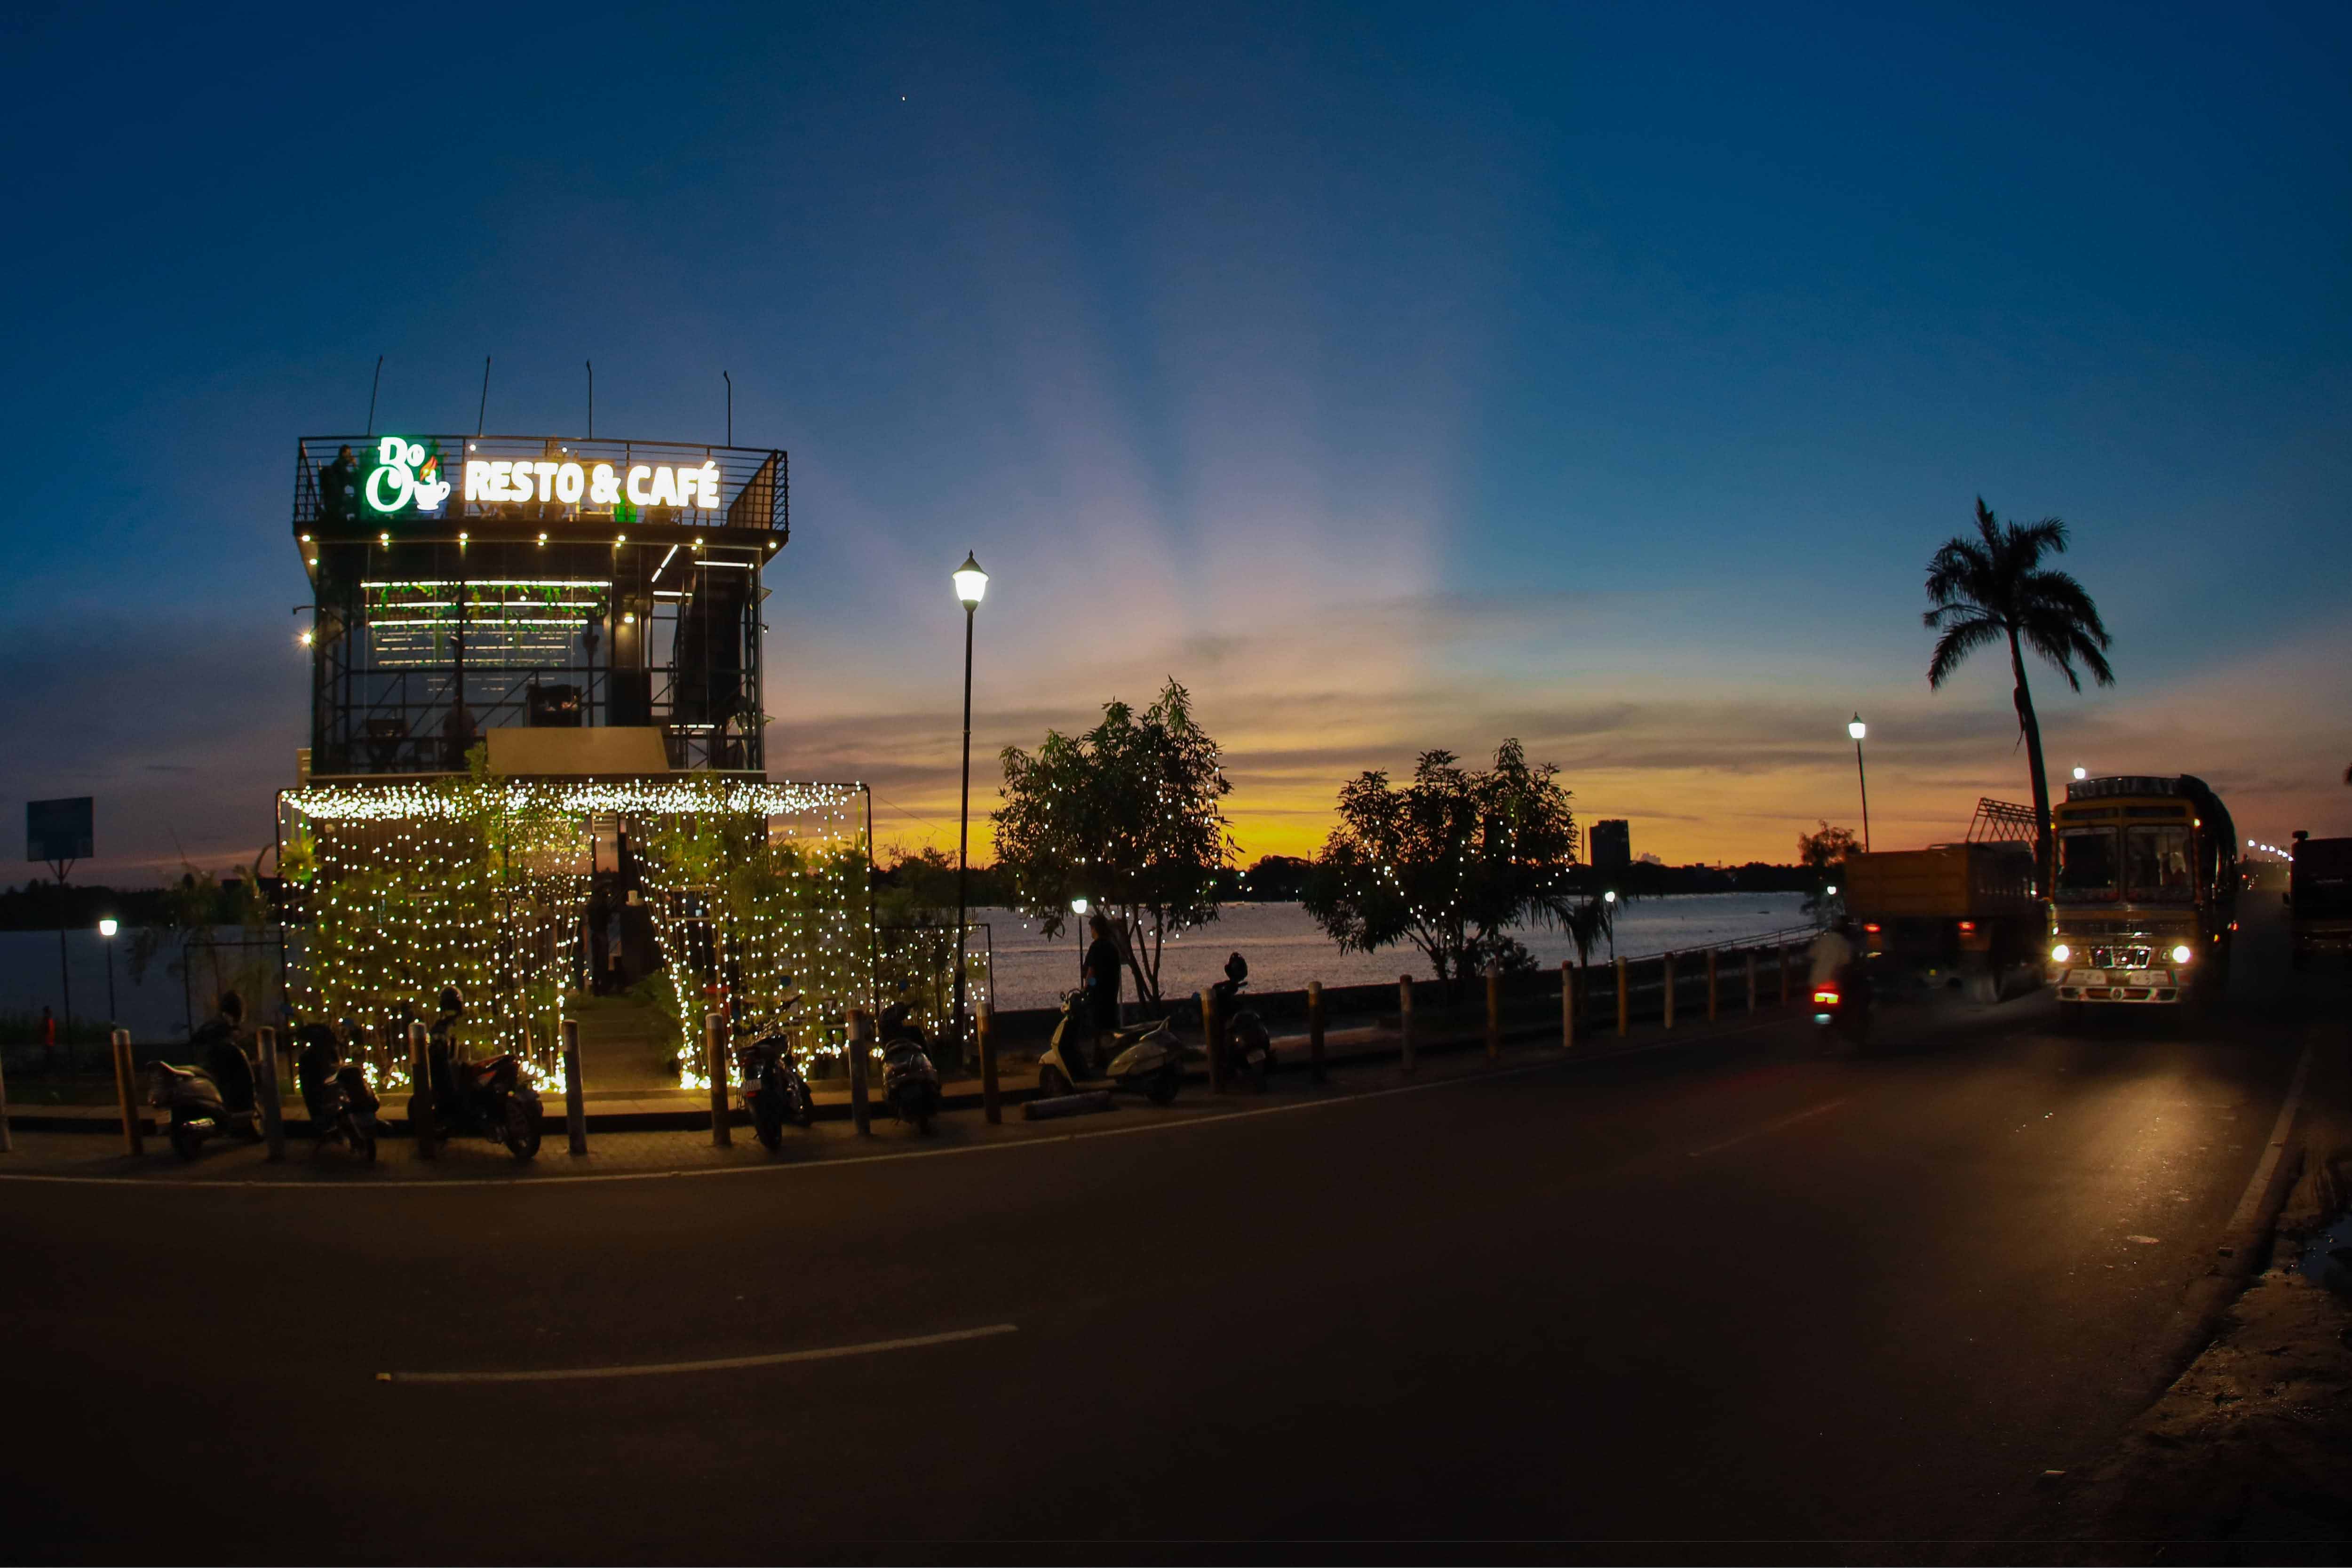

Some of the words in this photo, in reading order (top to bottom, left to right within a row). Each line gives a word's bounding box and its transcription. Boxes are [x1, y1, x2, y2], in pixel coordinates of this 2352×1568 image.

[465, 461, 585, 503] RESTO
[590, 463, 621, 504] &
[627, 460, 720, 509] CAFÉ
